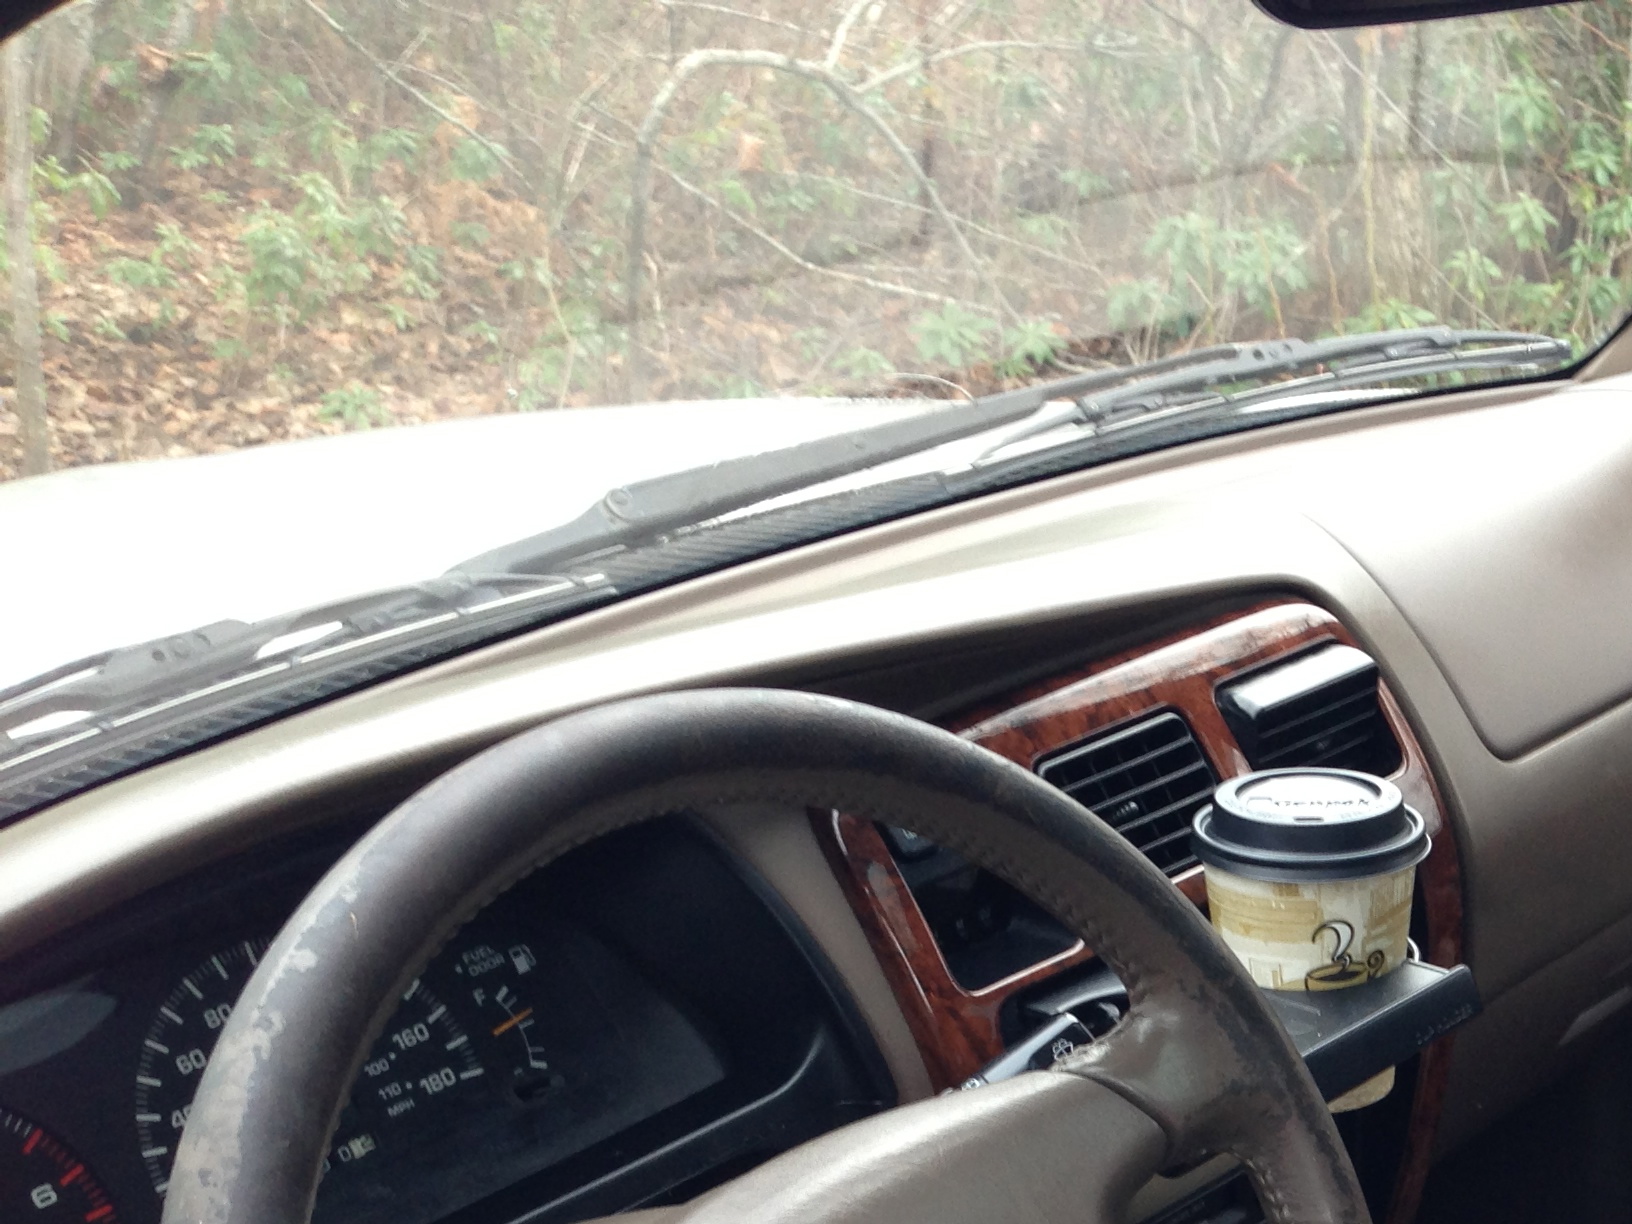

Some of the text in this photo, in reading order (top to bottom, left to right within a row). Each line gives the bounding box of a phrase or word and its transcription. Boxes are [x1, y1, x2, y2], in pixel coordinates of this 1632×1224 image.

[392, 1023, 430, 1050] 160
[176, 1048, 207, 1075] 60
[364, 1057, 390, 1078] 100
[378, 1082, 402, 1101] 110
[419, 1066, 457, 1095] 180
[387, 1098, 415, 1118] MPH
[30, 1182, 57, 1210] 6
